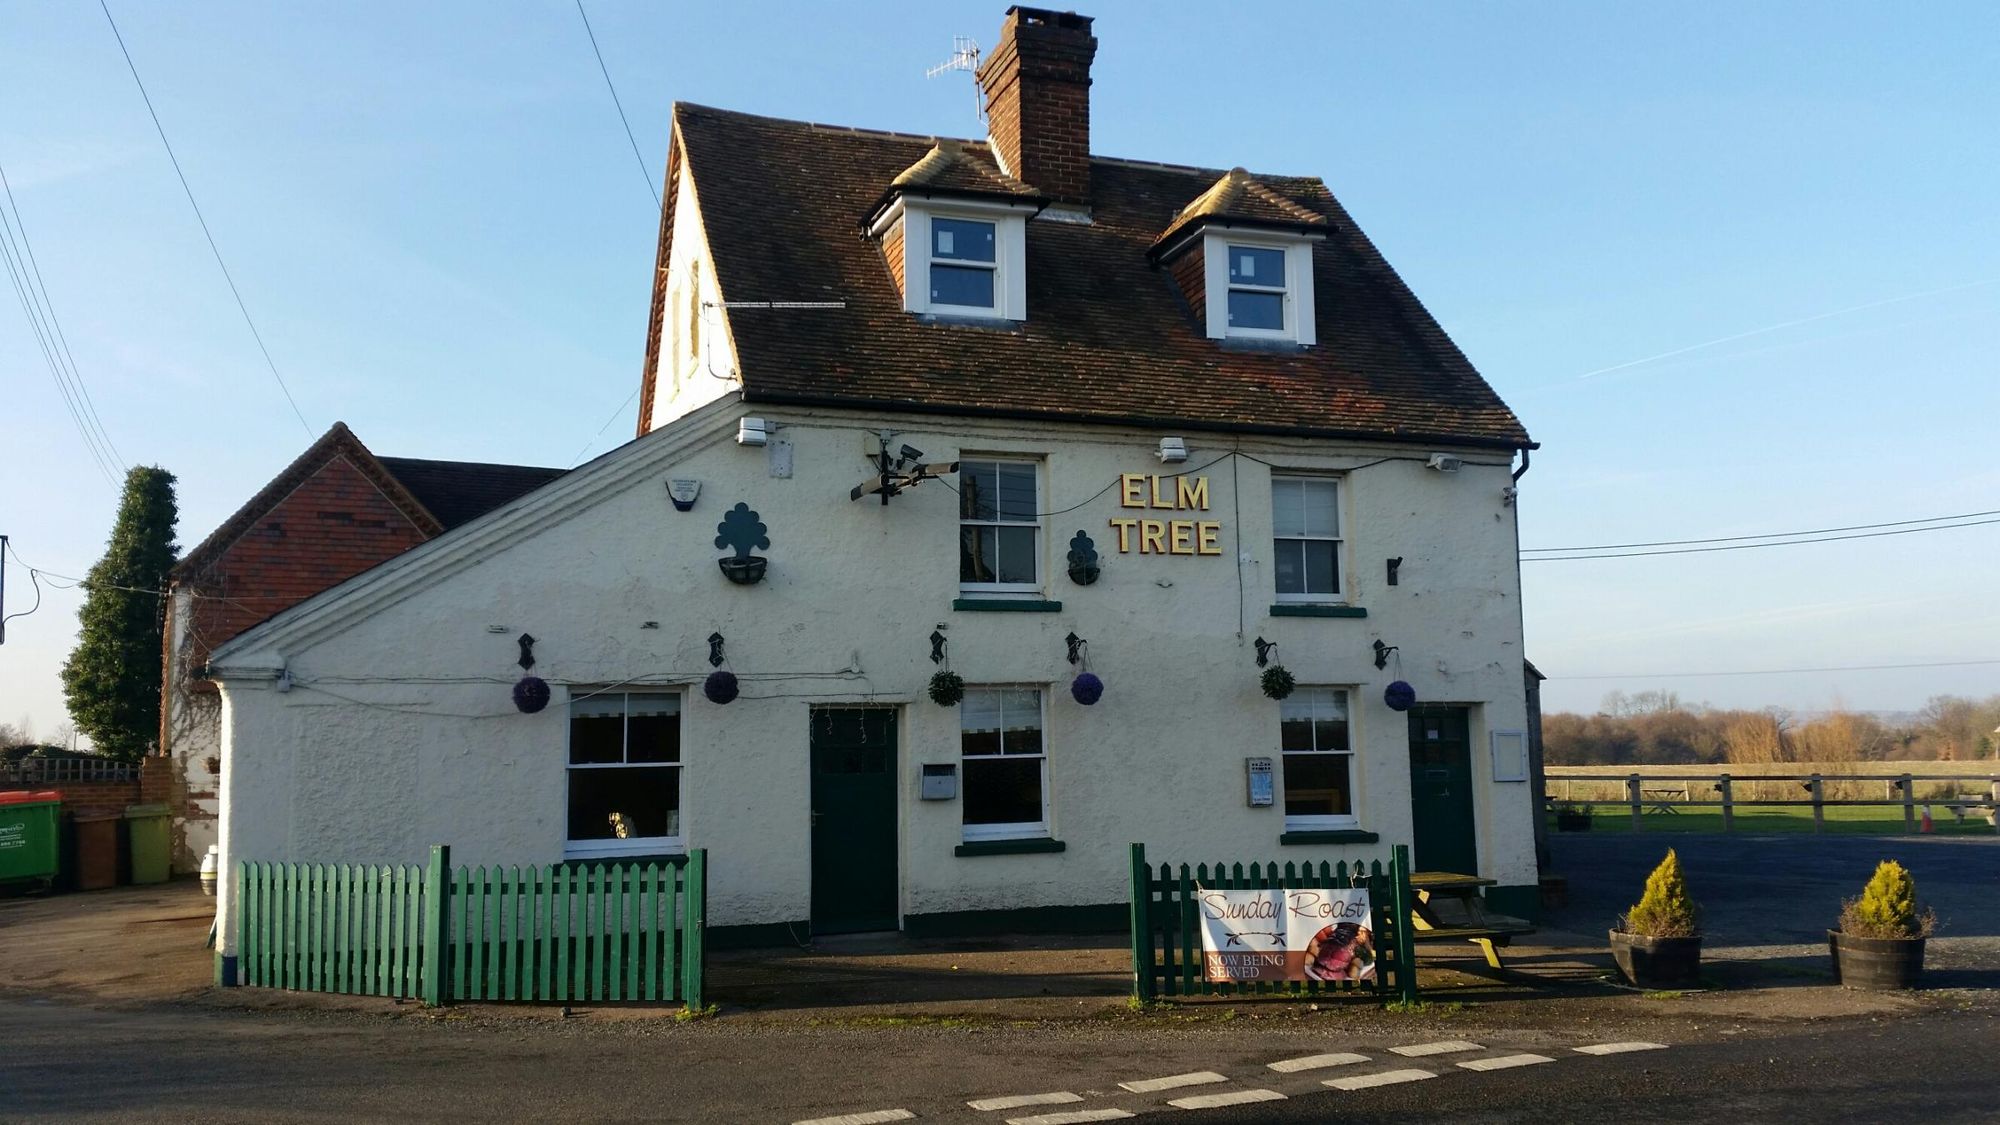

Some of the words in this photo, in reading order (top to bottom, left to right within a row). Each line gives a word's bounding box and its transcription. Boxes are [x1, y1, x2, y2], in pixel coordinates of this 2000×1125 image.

[1120, 473, 1209, 510] ELM
[1109, 518, 1223, 556] TREE
[1204, 893, 1283, 929] Sunday
[1289, 892, 1365, 918] Roast
[1208, 954, 1240, 967] NOW
[1243, 954, 1285, 967] BEING
[1209, 966, 1260, 979] SERVED
